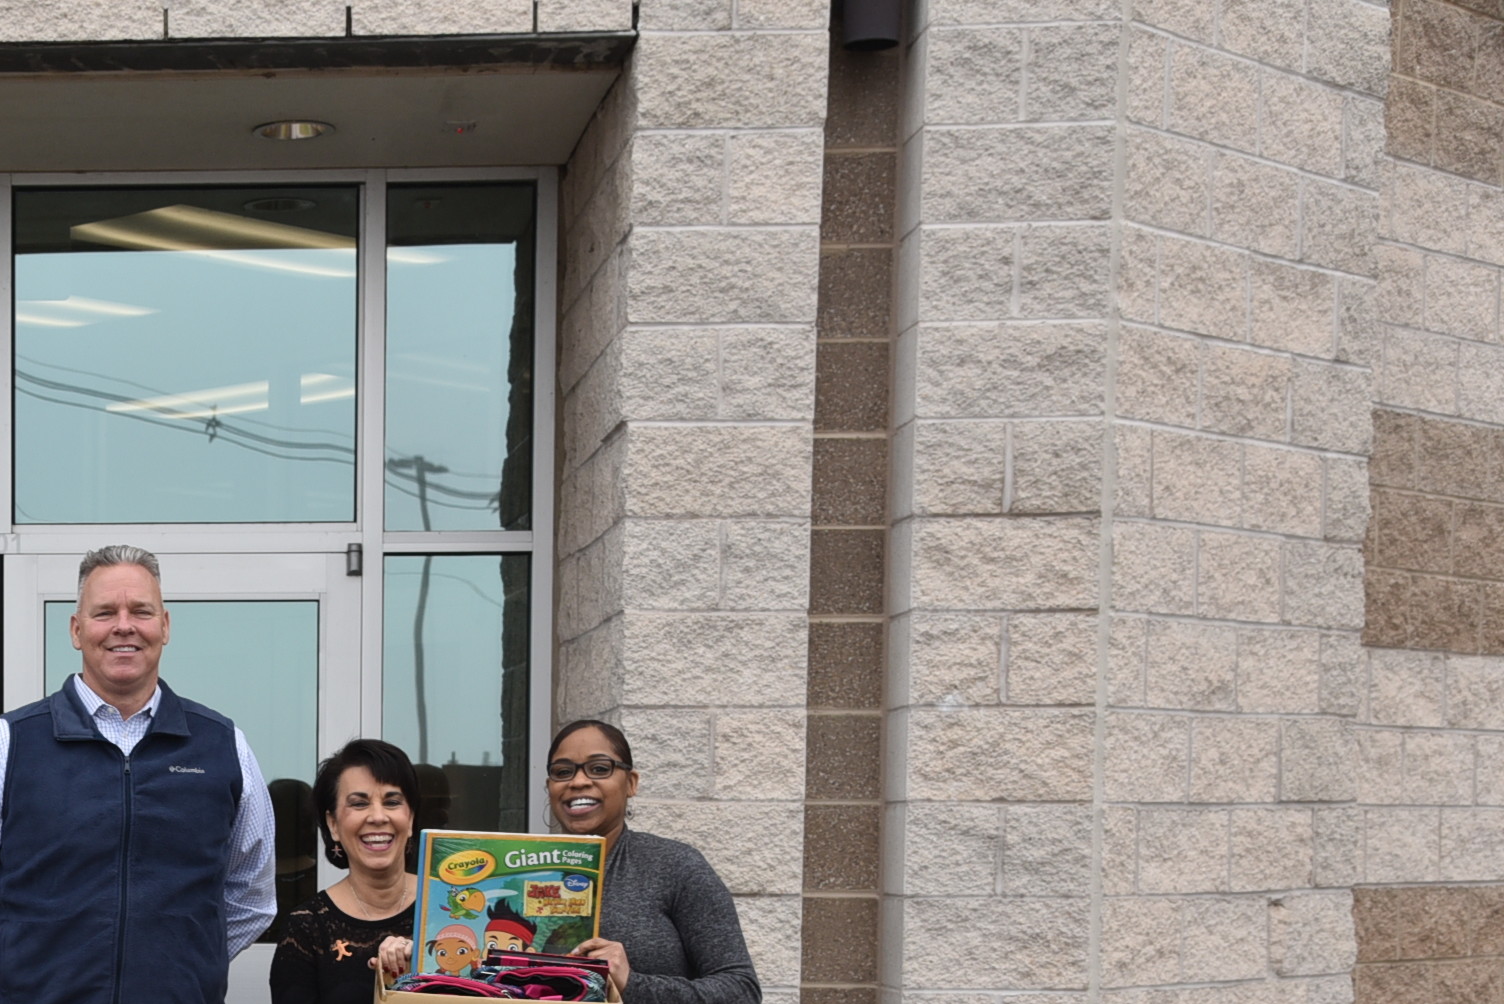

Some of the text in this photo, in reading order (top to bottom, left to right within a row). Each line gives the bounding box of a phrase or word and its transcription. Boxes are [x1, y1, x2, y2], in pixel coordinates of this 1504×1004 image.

[176, 766, 205, 774] Columbia
[504, 849, 561, 868] Giant
[562, 849, 594, 861] Coloring
[448, 856, 486, 871] Crayola
[562, 857, 582, 865] Pages
[565, 879, 589, 889] Disney
